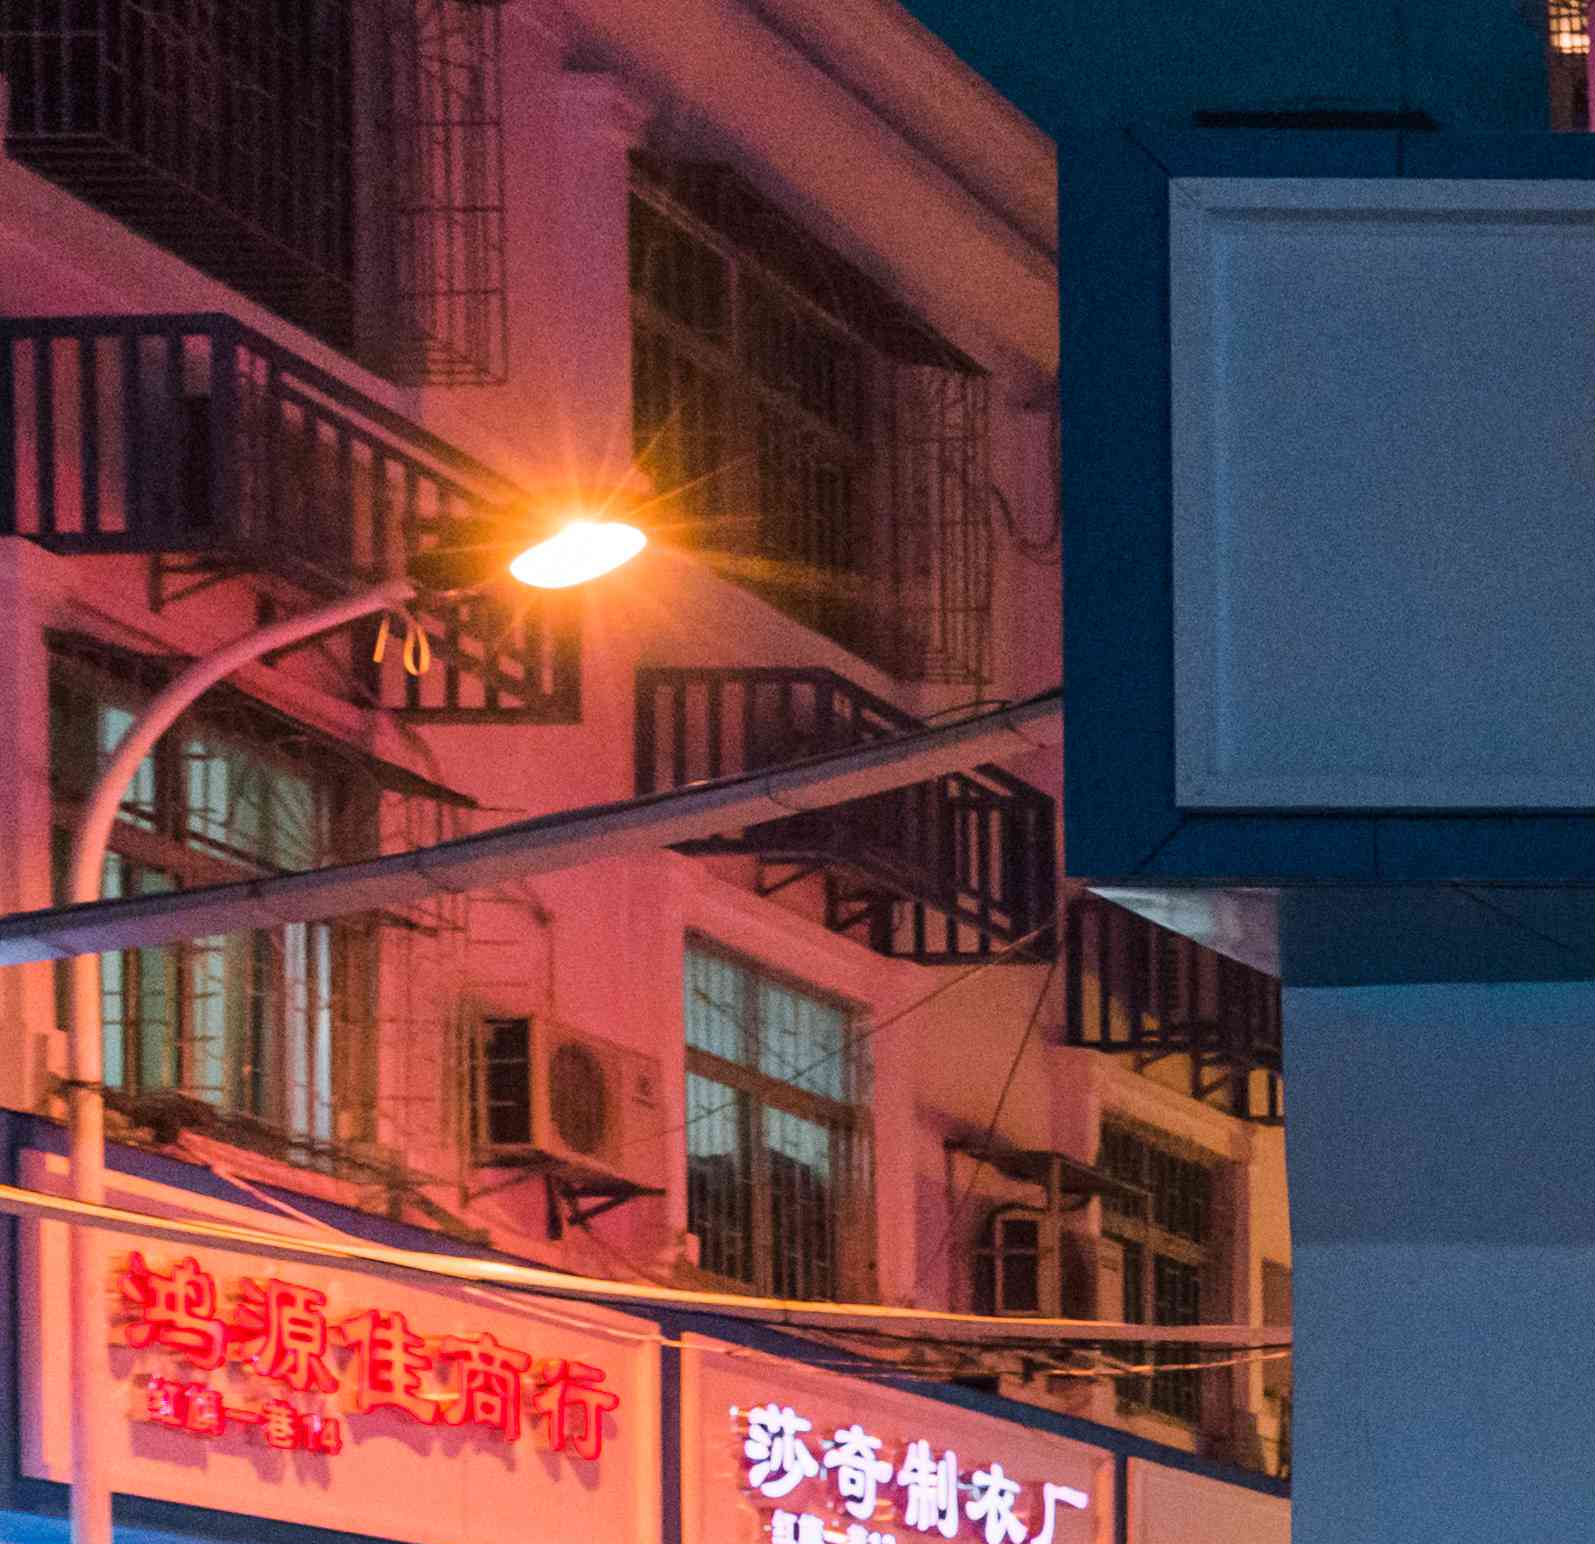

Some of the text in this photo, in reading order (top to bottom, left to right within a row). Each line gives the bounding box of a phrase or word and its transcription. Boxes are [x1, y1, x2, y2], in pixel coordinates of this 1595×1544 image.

[122, 1250, 620, 1460] 鸿源佳商行
